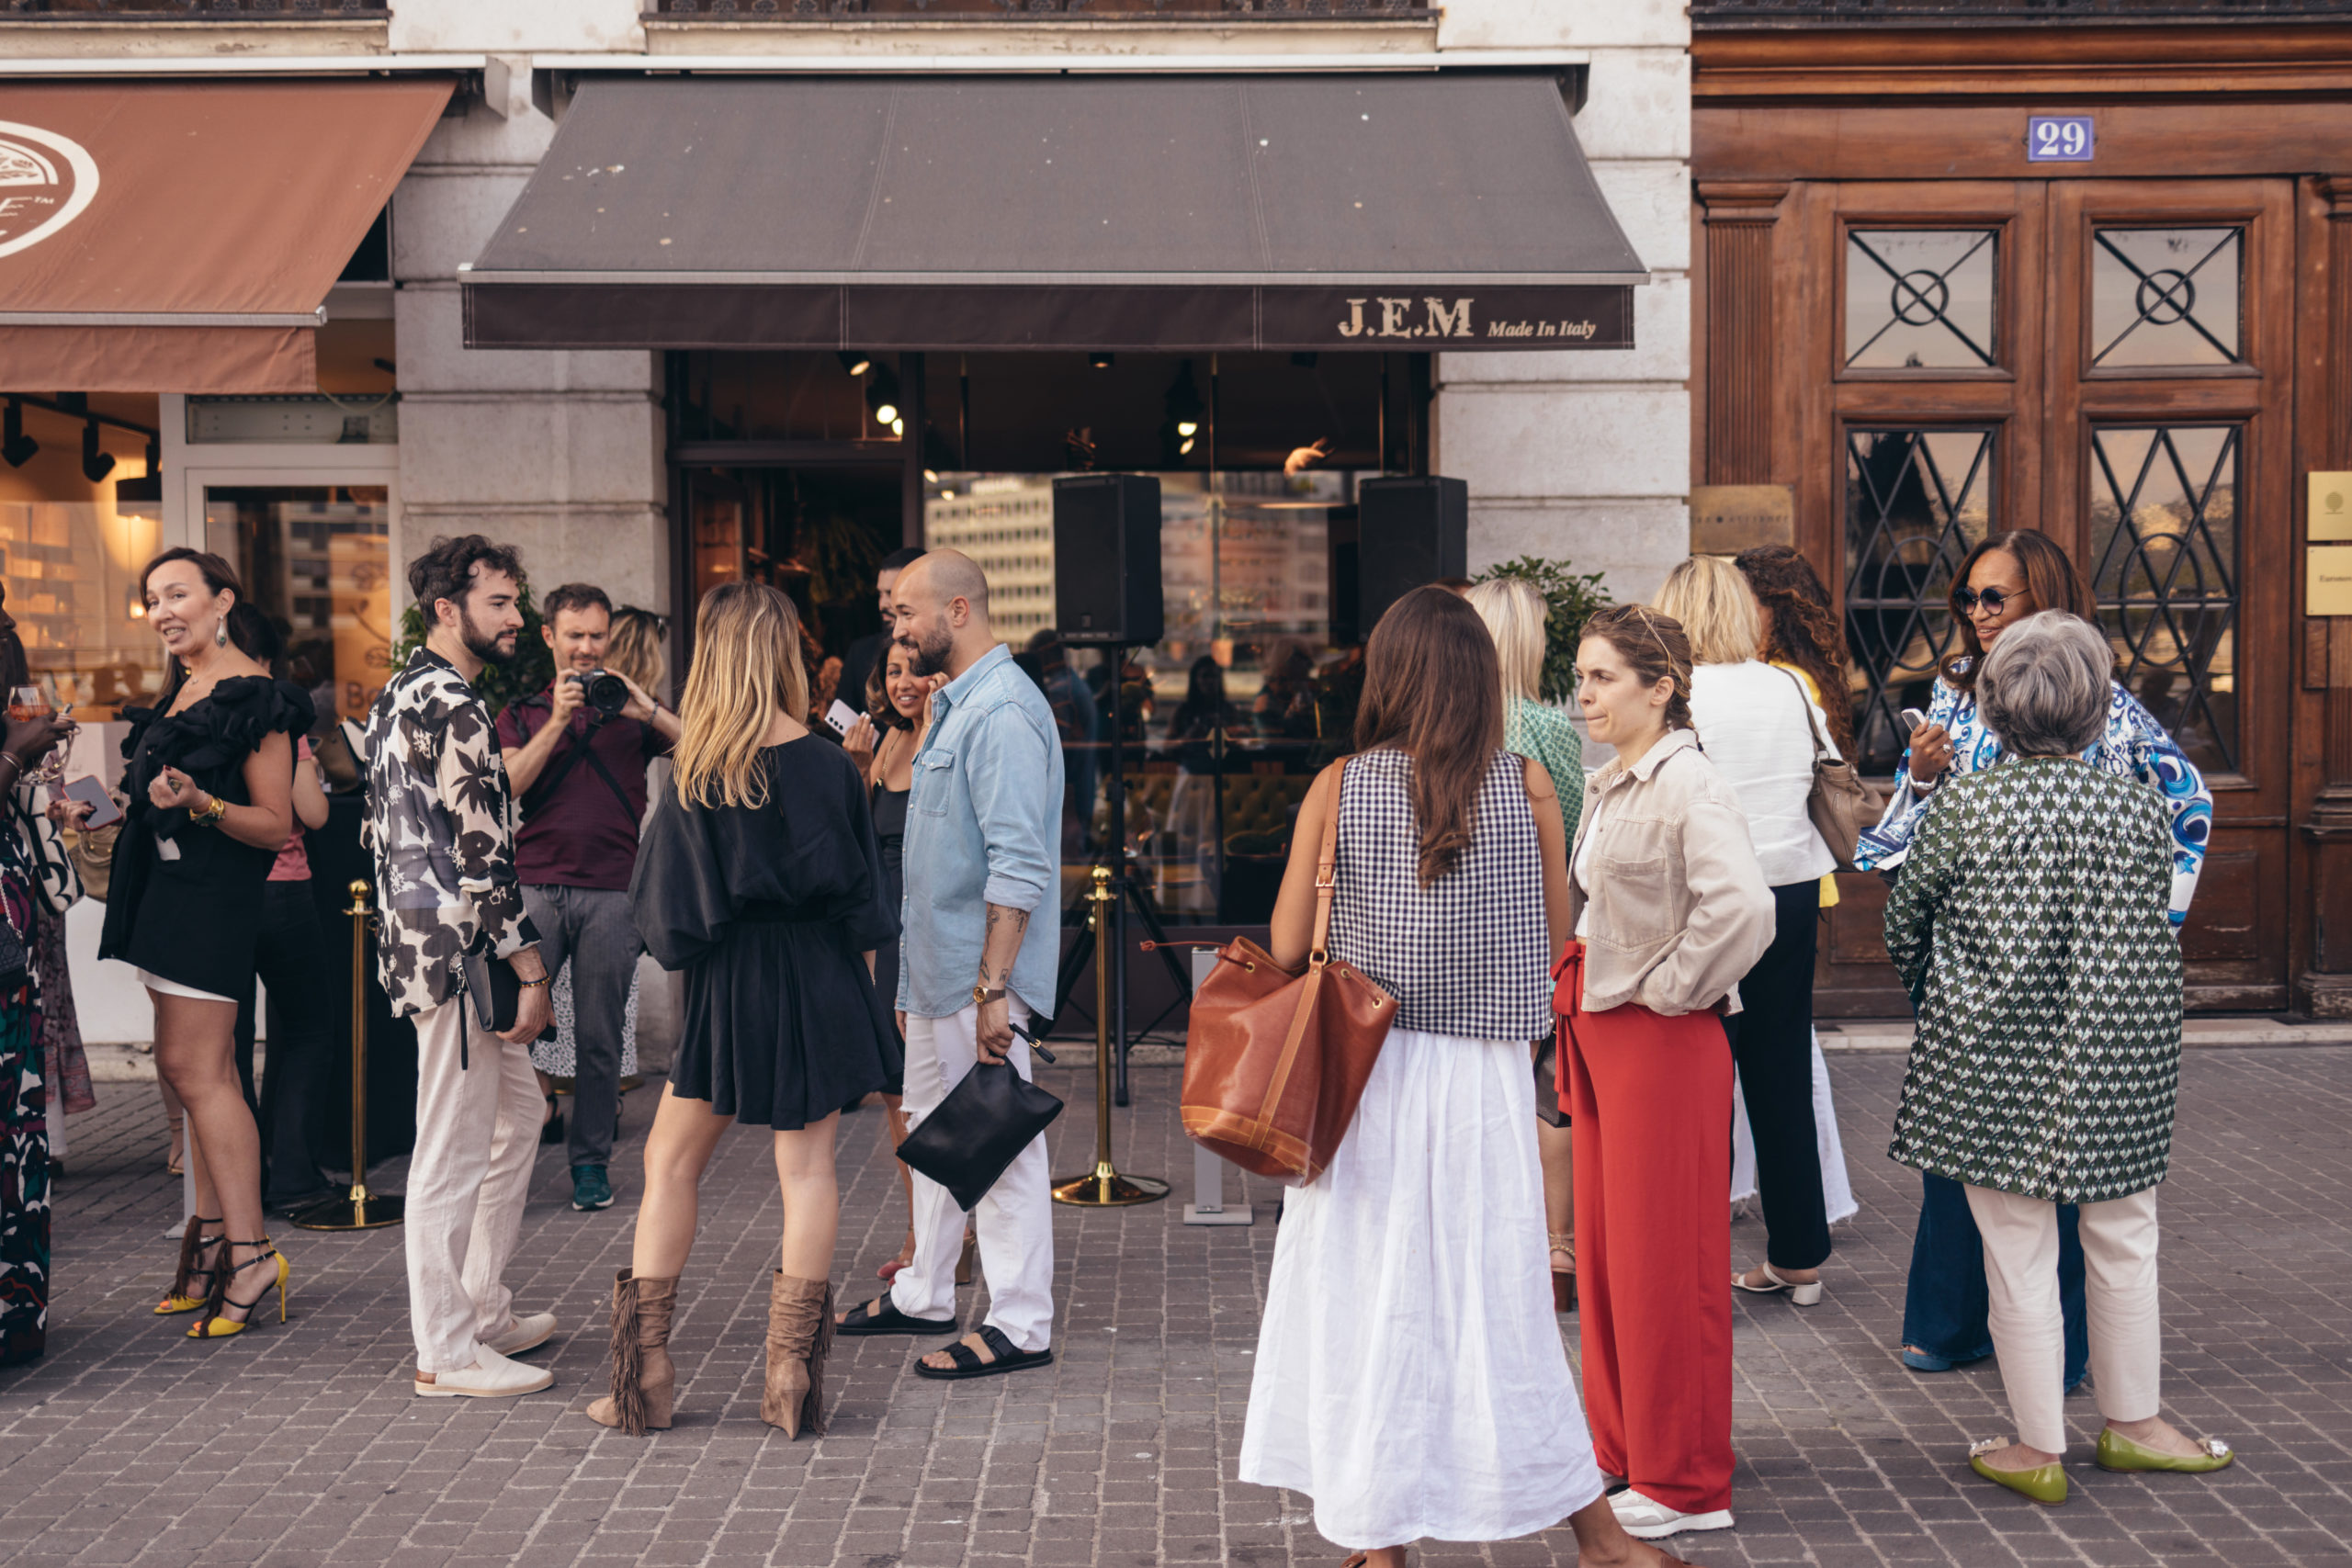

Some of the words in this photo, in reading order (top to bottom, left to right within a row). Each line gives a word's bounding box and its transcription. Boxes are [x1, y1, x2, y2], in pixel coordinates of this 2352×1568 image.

[2037, 121, 2085, 155] 29
[1338, 297, 1475, 339] J.E.M
[1487, 320, 1533, 337] Made
[1536, 321, 1555, 337] In
[1558, 320, 1597, 340] Italy
